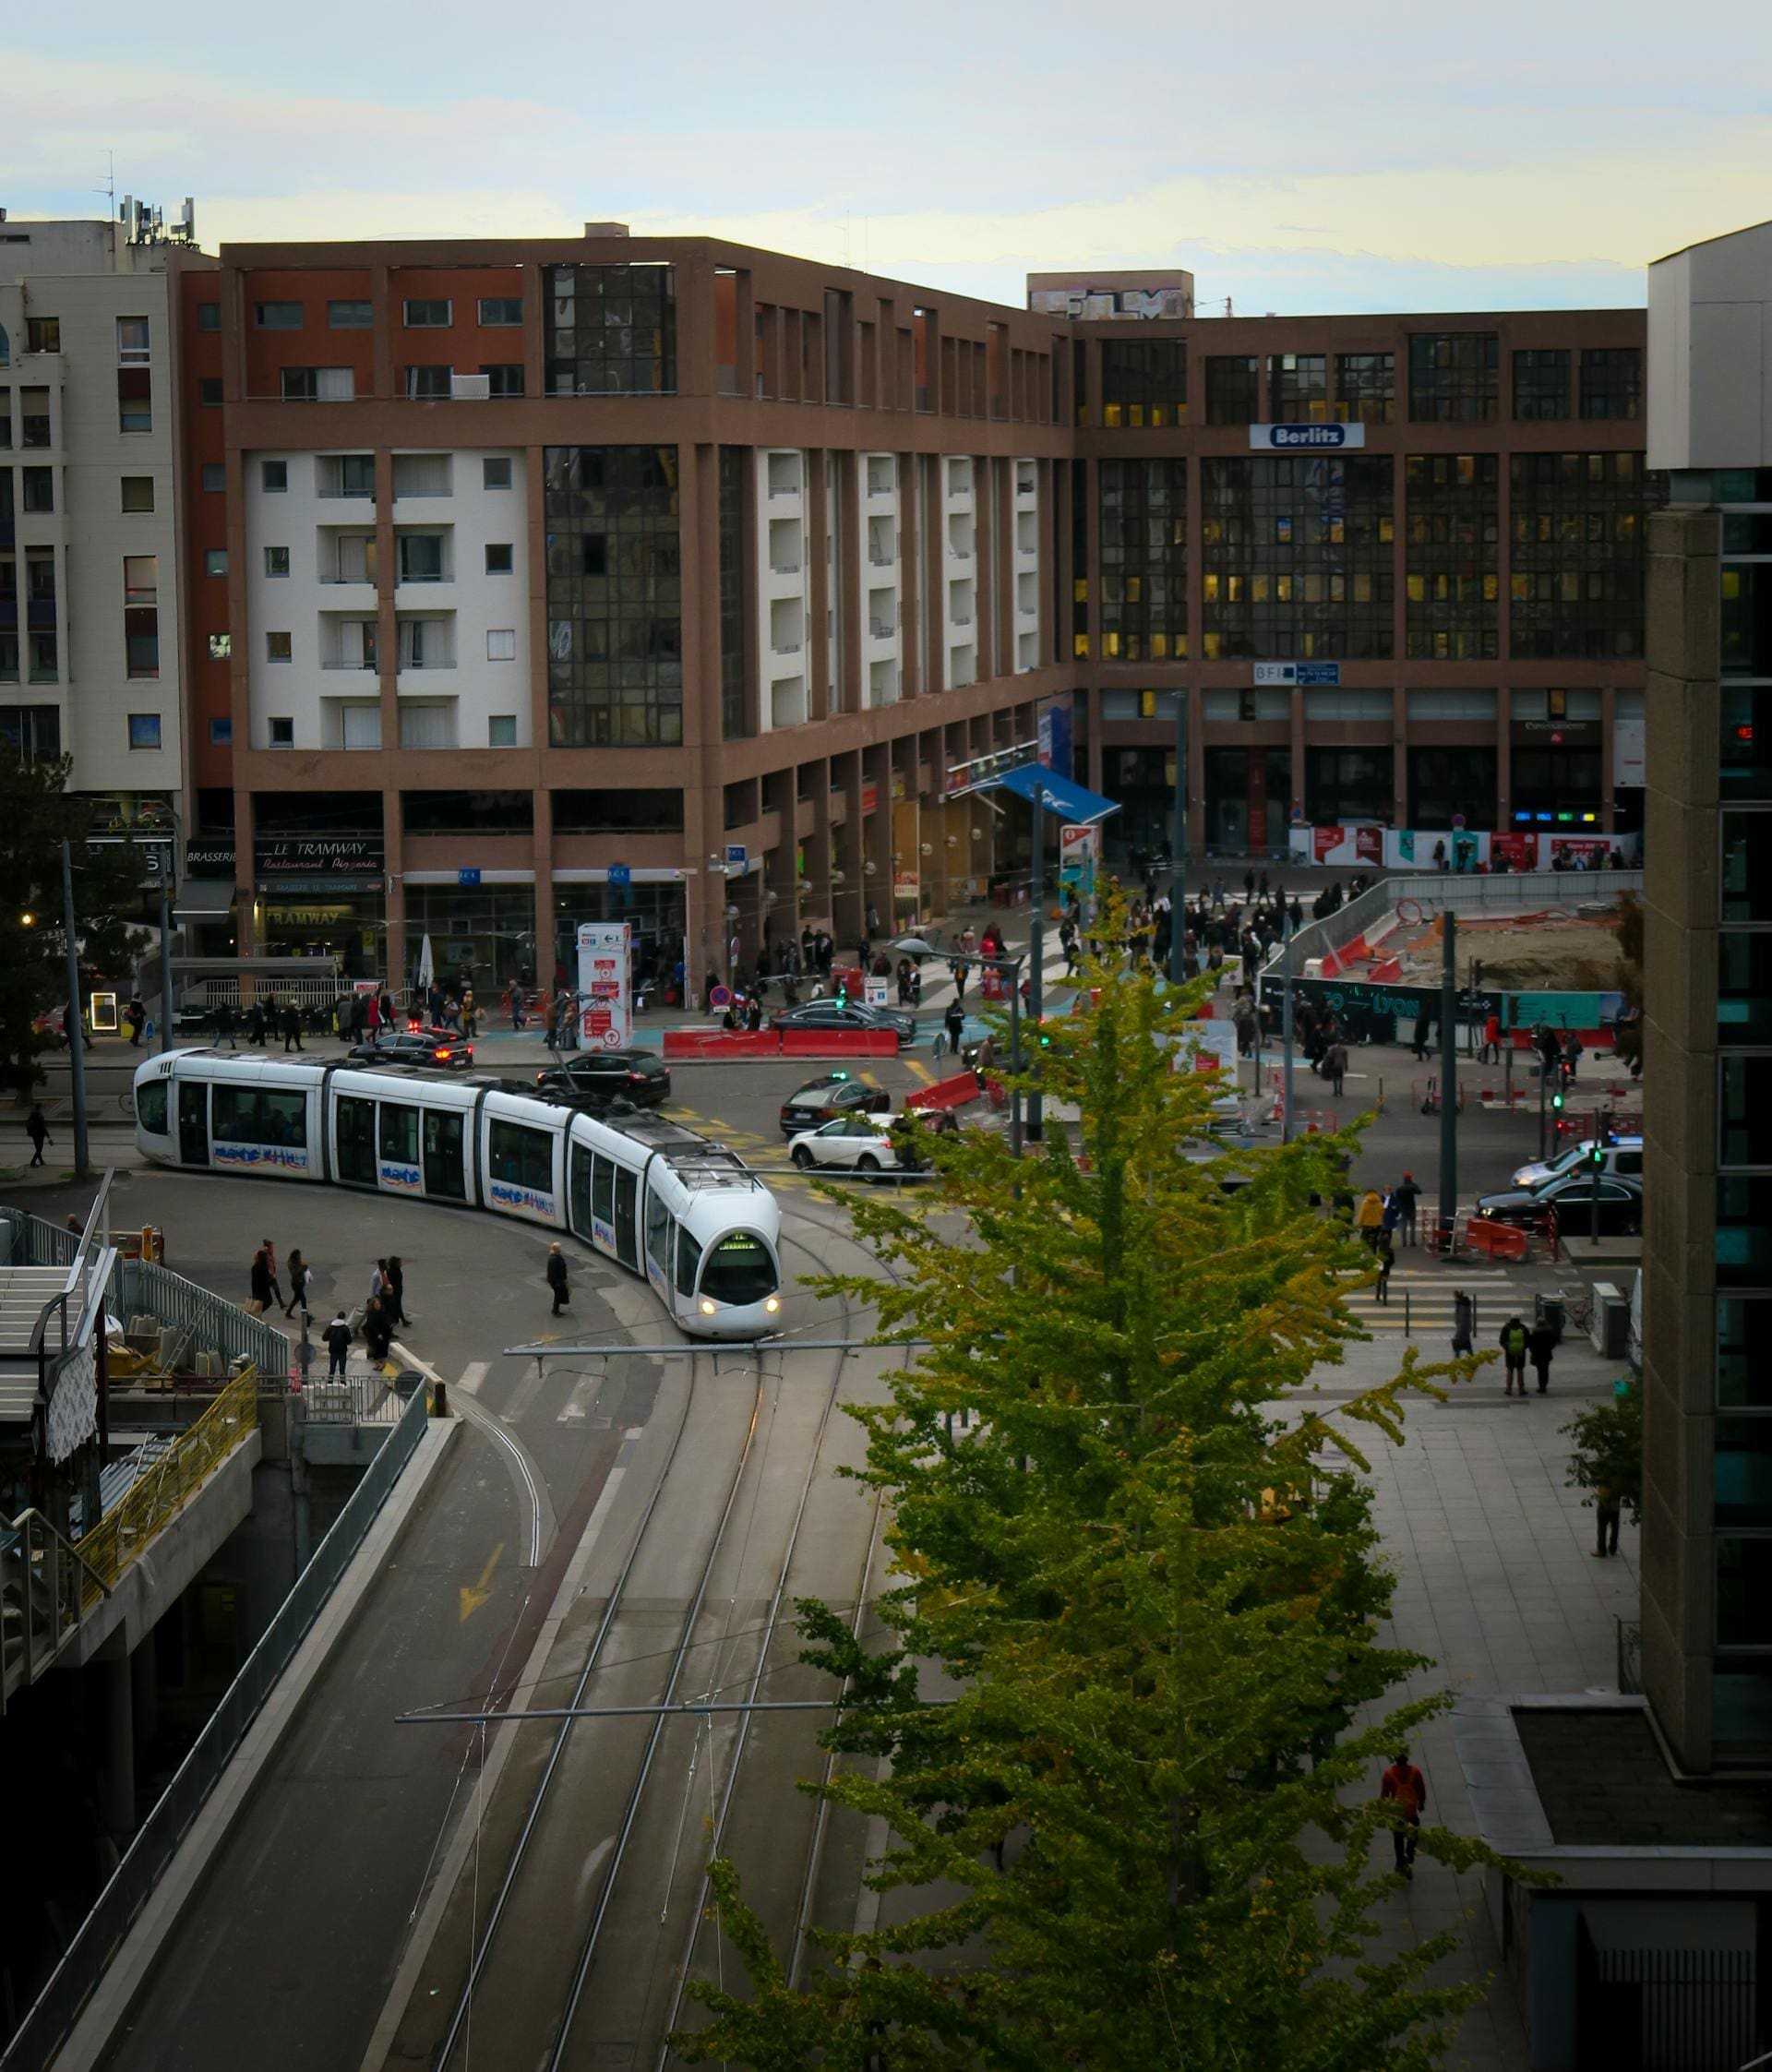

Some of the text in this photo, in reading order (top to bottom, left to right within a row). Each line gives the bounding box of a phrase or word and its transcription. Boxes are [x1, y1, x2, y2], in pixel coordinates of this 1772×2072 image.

[1275, 426, 1340, 444] Berlitz
[273, 841, 367, 856] LE TRAMWAY
[186, 851, 237, 863] BRASSERIE
[262, 857, 325, 870] Restaurant
